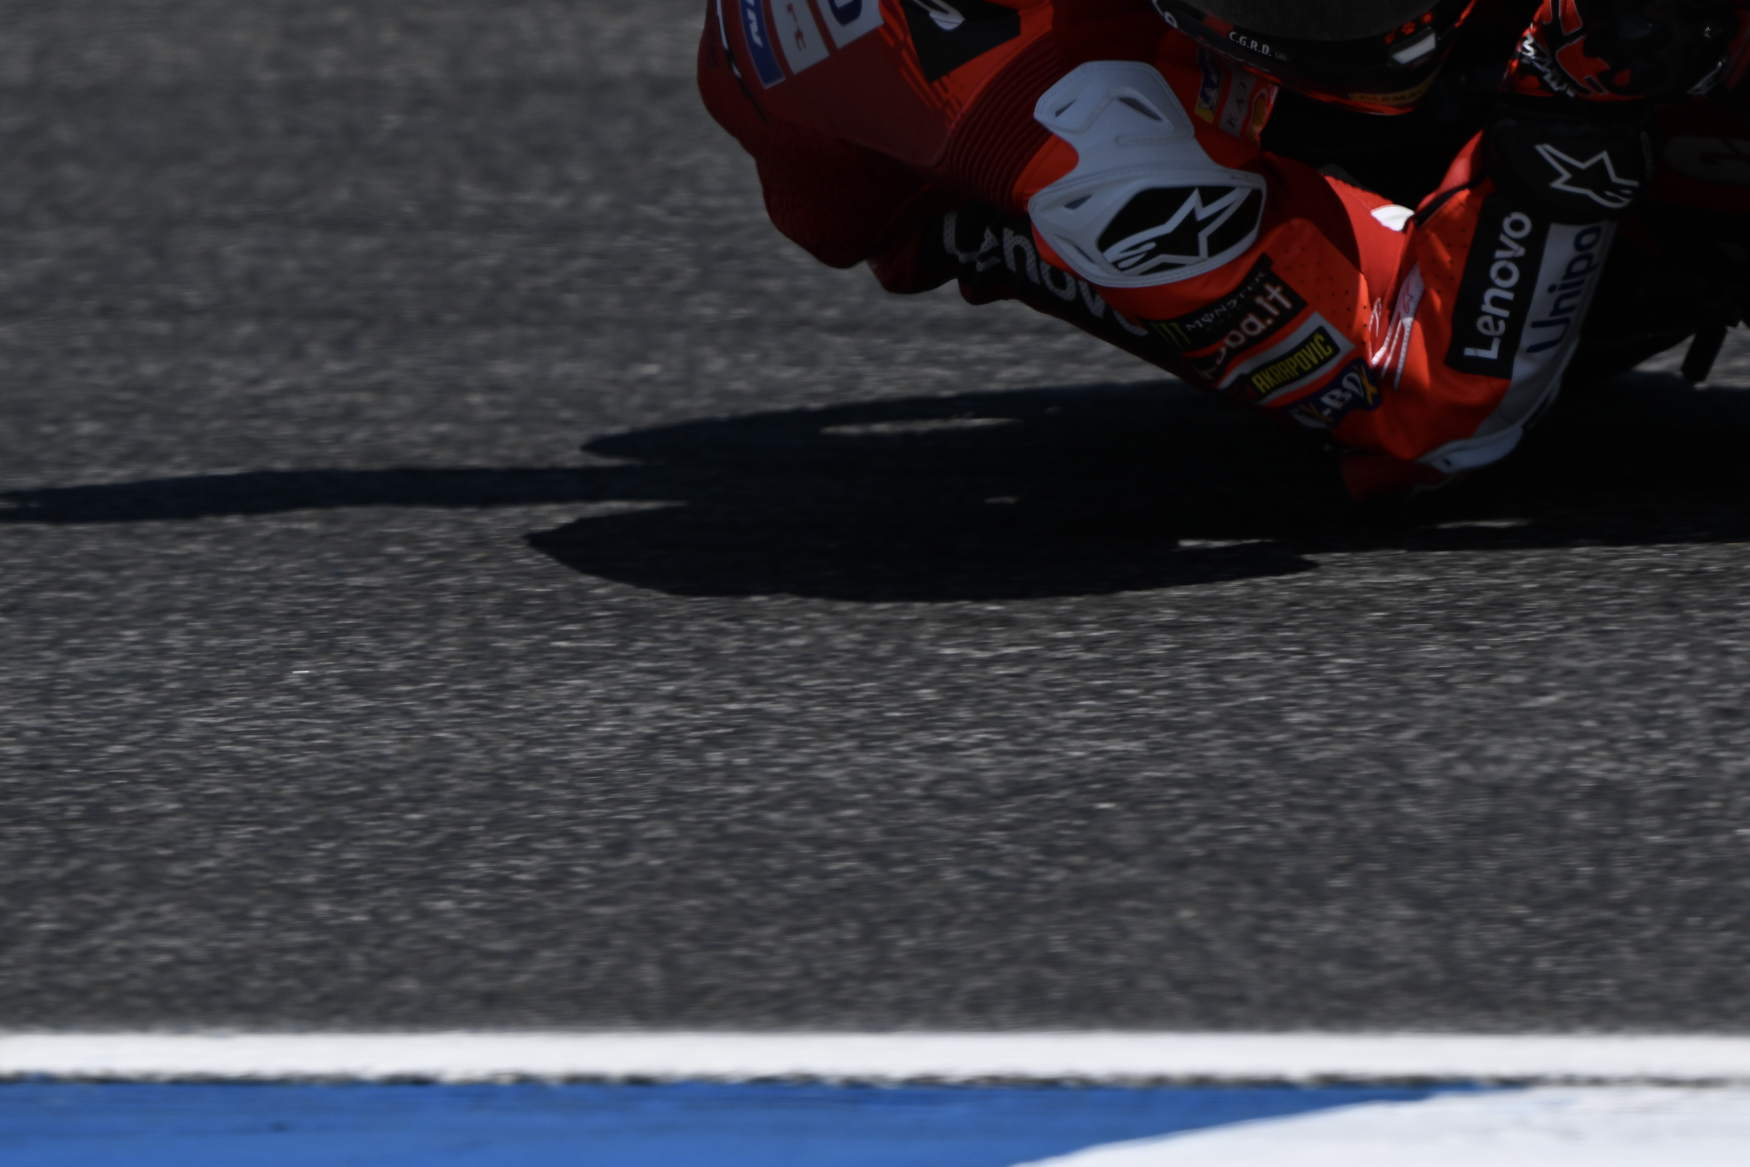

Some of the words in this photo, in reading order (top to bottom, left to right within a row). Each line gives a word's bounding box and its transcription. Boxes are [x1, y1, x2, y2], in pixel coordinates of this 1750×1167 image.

[1229, 31, 1272, 57] C.G.R.D.
[1463, 211, 1533, 360] Lenovo
[1526, 225, 1602, 353] Unipo
